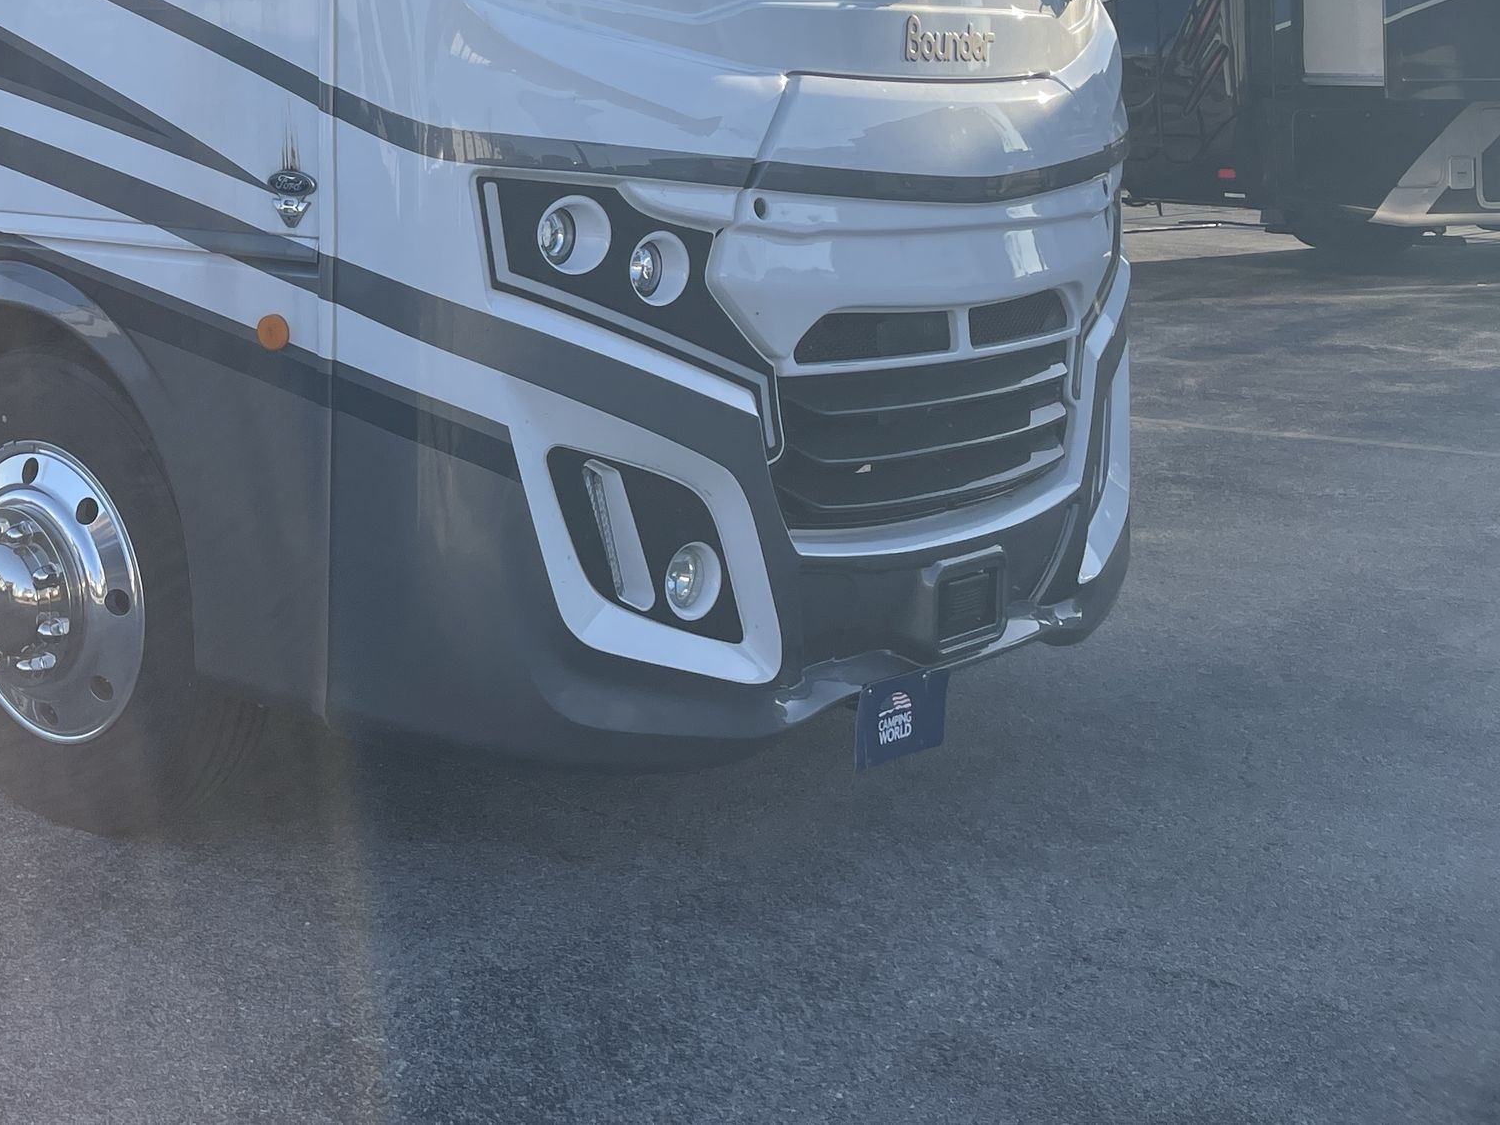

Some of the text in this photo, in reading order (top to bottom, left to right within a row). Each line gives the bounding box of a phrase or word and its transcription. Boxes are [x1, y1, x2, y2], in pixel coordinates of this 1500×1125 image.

[905, 14, 995, 62] Bounder
[275, 175, 303, 191] Ford
[878, 711, 913, 731] CAMPING
[878, 724, 913, 745] WORLD
